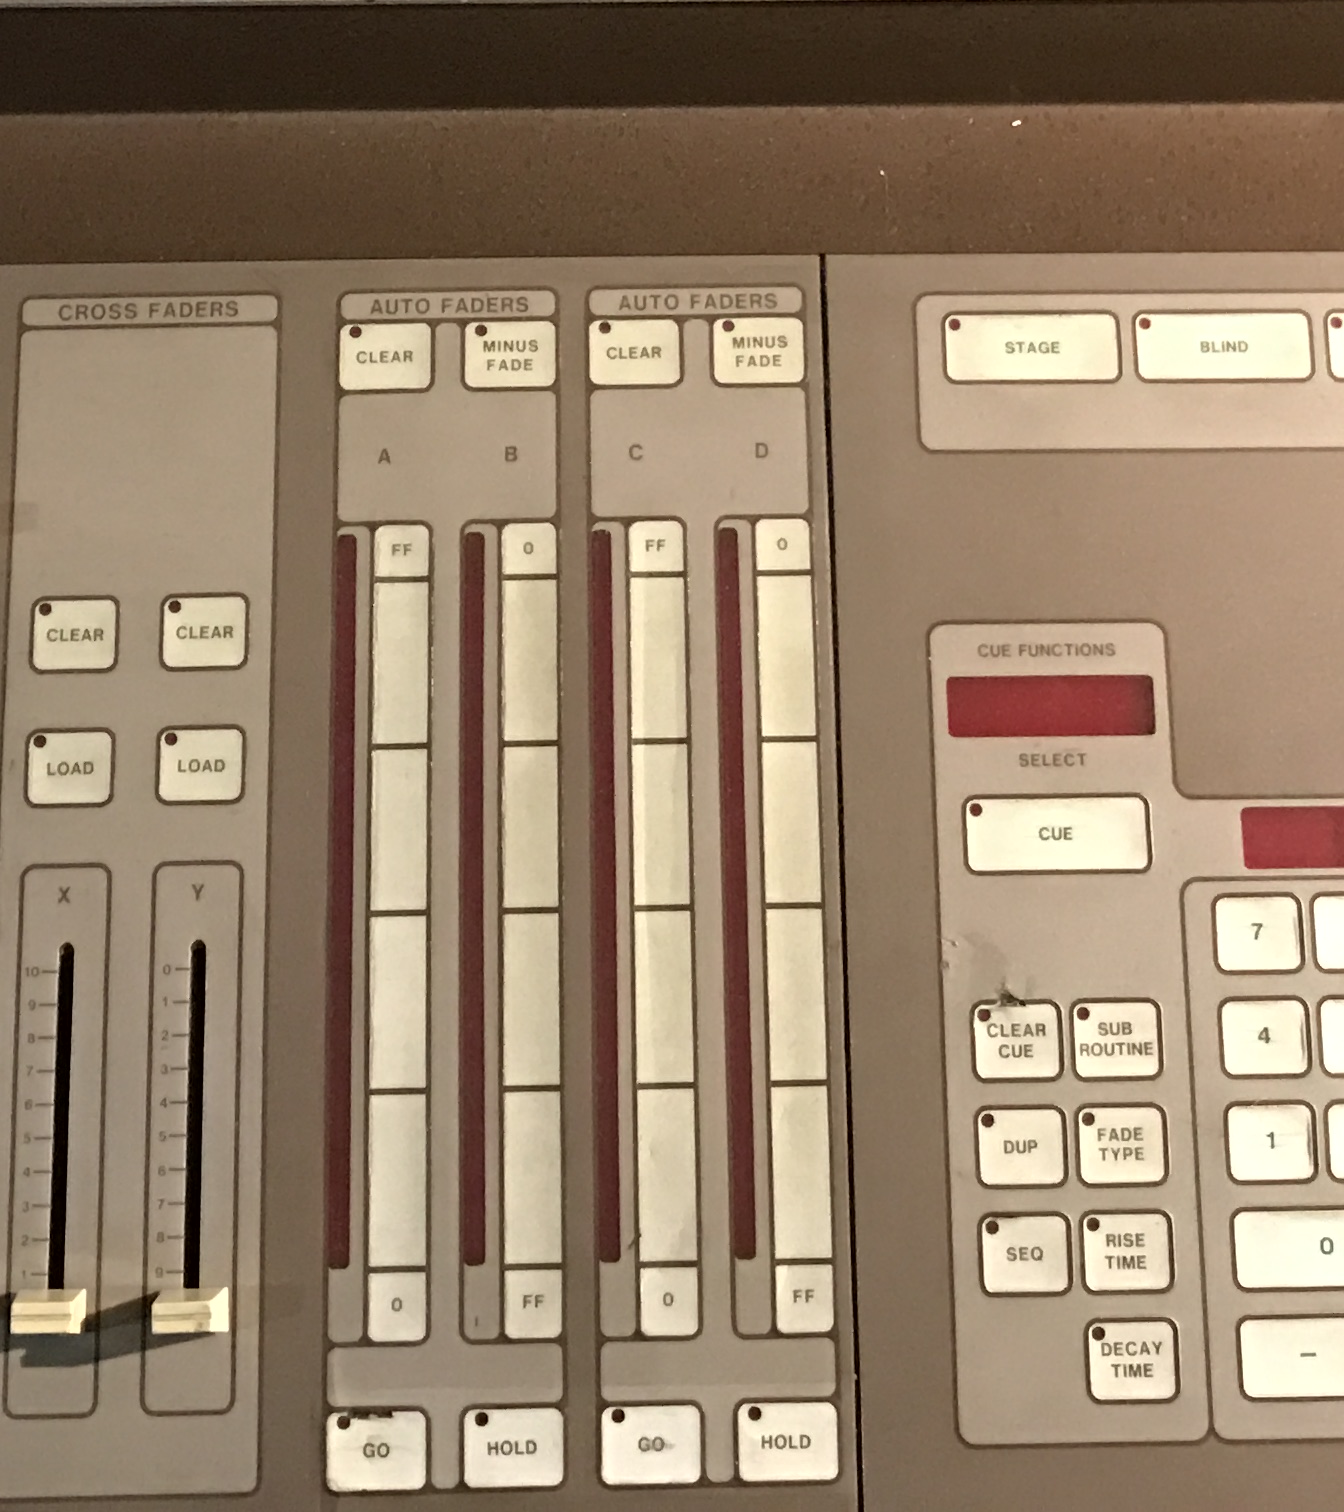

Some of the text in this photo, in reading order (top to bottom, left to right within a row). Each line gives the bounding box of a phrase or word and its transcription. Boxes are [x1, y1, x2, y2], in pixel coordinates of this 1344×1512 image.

[371, 296, 528, 315] AUTO FADERS
[619, 293, 777, 311] AUTO FADERS
[58, 301, 238, 321] CROSS FADERS
[483, 340, 538, 352] MINUS
[732, 335, 788, 349] MINUS
[1005, 341, 1060, 354] STAGE
[1200, 341, 1248, 353] BLIND
[356, 351, 413, 364] CLEAR
[606, 346, 661, 359] CLEAR
[487, 359, 533, 371] FADE
[736, 355, 781, 367] FADE
[378, 448, 391, 464] A
[505, 446, 518, 462] B
[629, 444, 643, 461] C
[755, 443, 768, 458] D
[392, 543, 412, 556] FF
[523, 542, 534, 554] 0
[646, 539, 665, 552] FF
[777, 537, 788, 550] 0
[47, 628, 103, 642] CLEAR
[176, 626, 233, 639] CLEAR
[978, 643, 1116, 658] CUE FUNCTIONS
[178, 759, 225, 773] LOAD
[1019, 753, 1086, 767] SELECT
[47, 761, 94, 776] LOAD
[1039, 827, 1072, 840] CUE
[58, 887, 70, 903] X
[192, 884, 204, 901] Y
[1251, 923, 1263, 940] 7
[26, 967, 39, 977] 10
[163, 964, 171, 975] 0
[28, 999, 36, 1011] 9
[163, 996, 168, 1007] 1
[161, 1030, 170, 1041] 2
[987, 1023, 1046, 1038] CLEAR
[1098, 1022, 1132, 1036] SUB
[1258, 1027, 1271, 1043] 4
[28, 1033, 35, 1044] 8
[999, 1044, 1033, 1058] CUE
[1080, 1042, 1153, 1056] ROUTINE
[26, 1065, 33, 1077] 7
[161, 1064, 169, 1075] 3
[24, 1099, 33, 1110] 6
[160, 1097, 167, 1108] 4
[23, 1132, 31, 1144] 5
[159, 1131, 167, 1142] 5
[1097, 1127, 1143, 1141] FADE
[1266, 1132, 1275, 1149] 1
[1004, 1140, 1038, 1154] DUP
[1099, 1147, 1144, 1161] TYPE
[23, 1167, 30, 1177] 4
[158, 1165, 166, 1176] 6
[22, 1200, 30, 1211] 3
[158, 1198, 165, 1210] 7
[21, 1234, 29, 1247] 2
[156, 1232, 165, 1243] 8
[1106, 1233, 1145, 1247] RISE
[1320, 1237, 1333, 1255] 0
[1007, 1247, 1043, 1261] SEQ
[1105, 1255, 1146, 1269] TIME
[22, 1269, 27, 1280] 1
[155, 1267, 163, 1278] 9
[523, 1295, 544, 1308] FF
[663, 1292, 674, 1306] 0
[793, 1289, 814, 1303] FF
[391, 1297, 402, 1312] 0
[1101, 1341, 1162, 1356] DECAY
[1111, 1363, 1153, 1378] TIME
[488, 1440, 537, 1455] HOLD
[638, 1437, 668, 1452] GO
[761, 1434, 811, 1449] HOLD
[363, 1442, 390, 1458] GO
